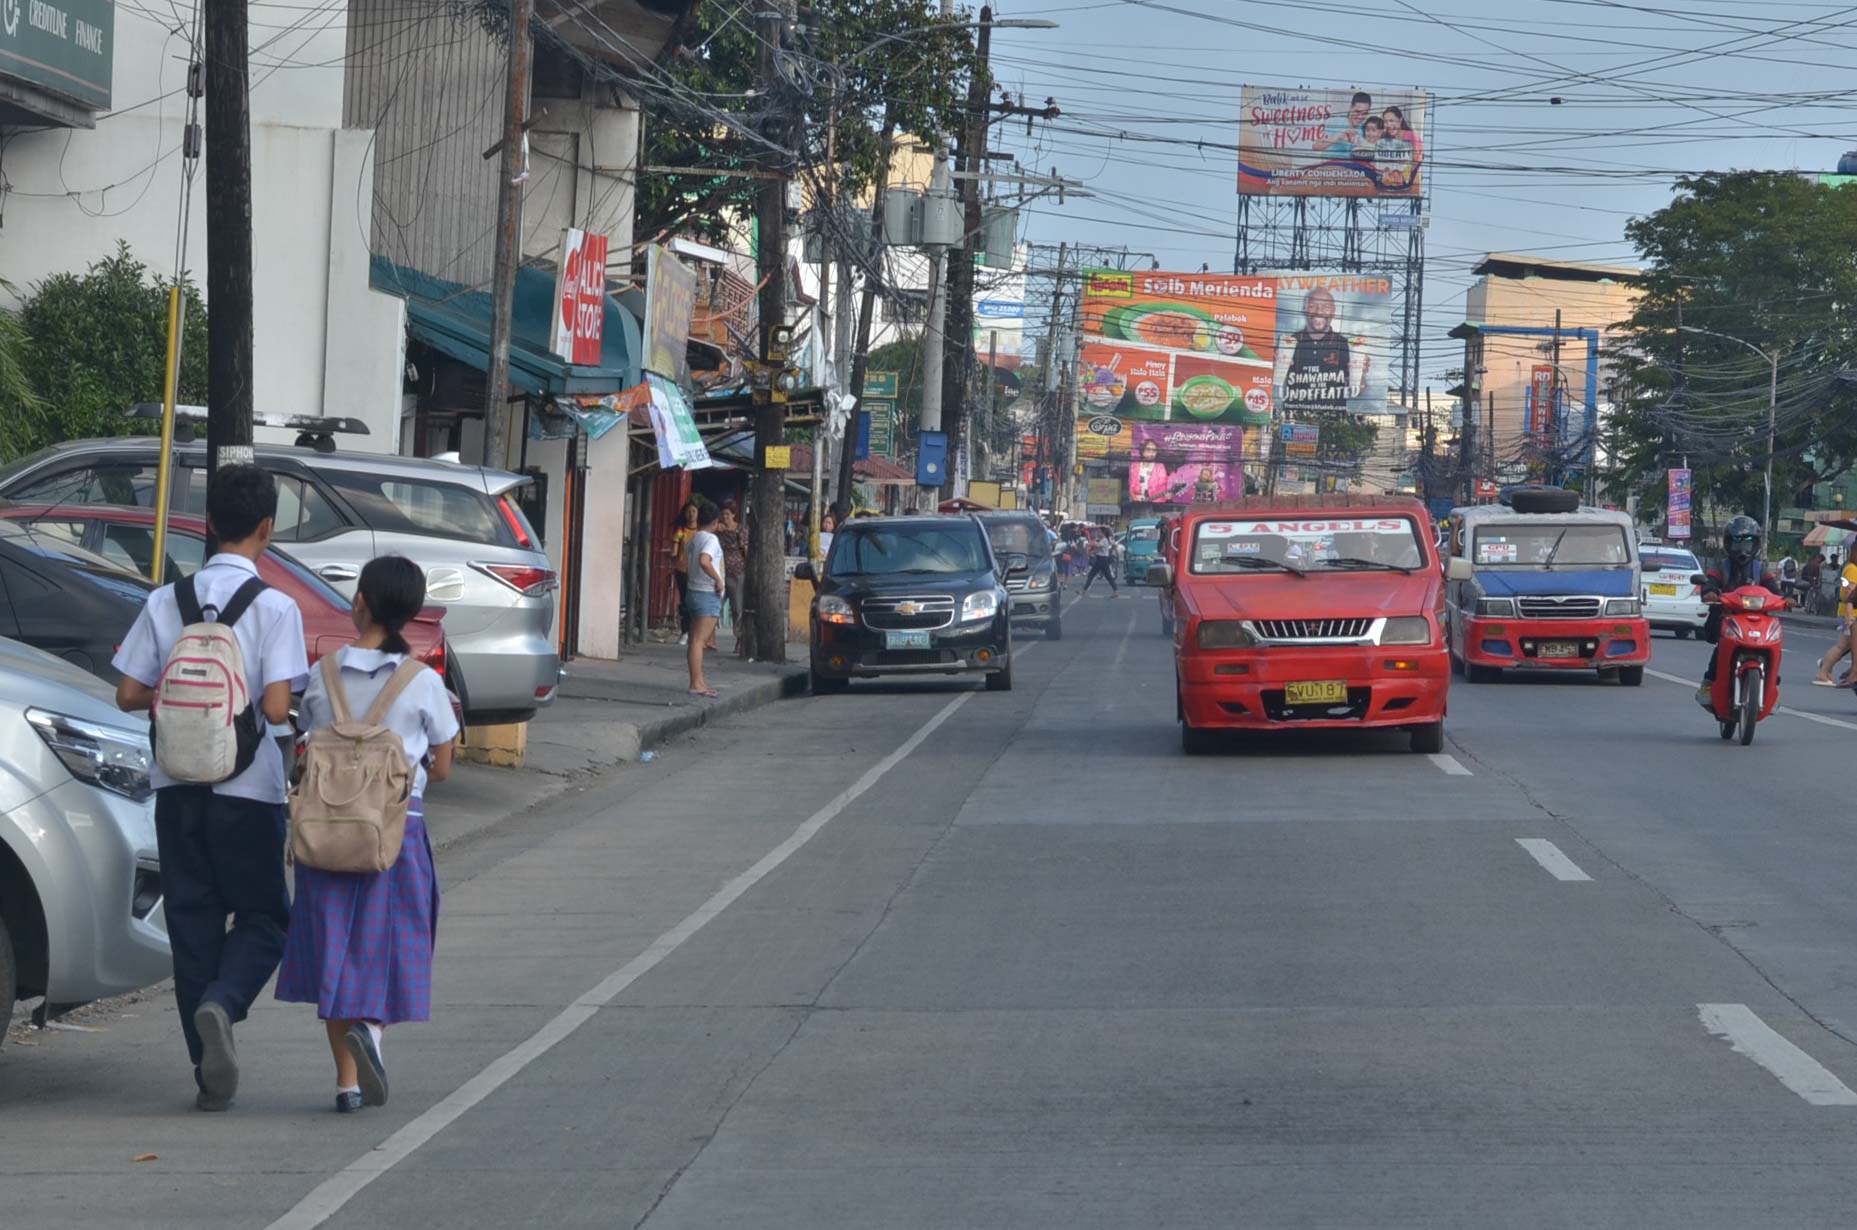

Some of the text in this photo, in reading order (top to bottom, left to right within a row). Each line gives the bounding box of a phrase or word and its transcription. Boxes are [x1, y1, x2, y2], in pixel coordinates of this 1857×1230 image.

[29, 0, 67, 39] CREDITLINE
[75, 19, 103, 55] FINANCE
[1250, 104, 1332, 127] Sweetness
[1271, 169, 1306, 178] LIBERTY
[1190, 280, 1273, 299] Merienda
[1288, 370, 1346, 386] SHAWARMA
[1250, 519, 1402, 533] ANGELS
